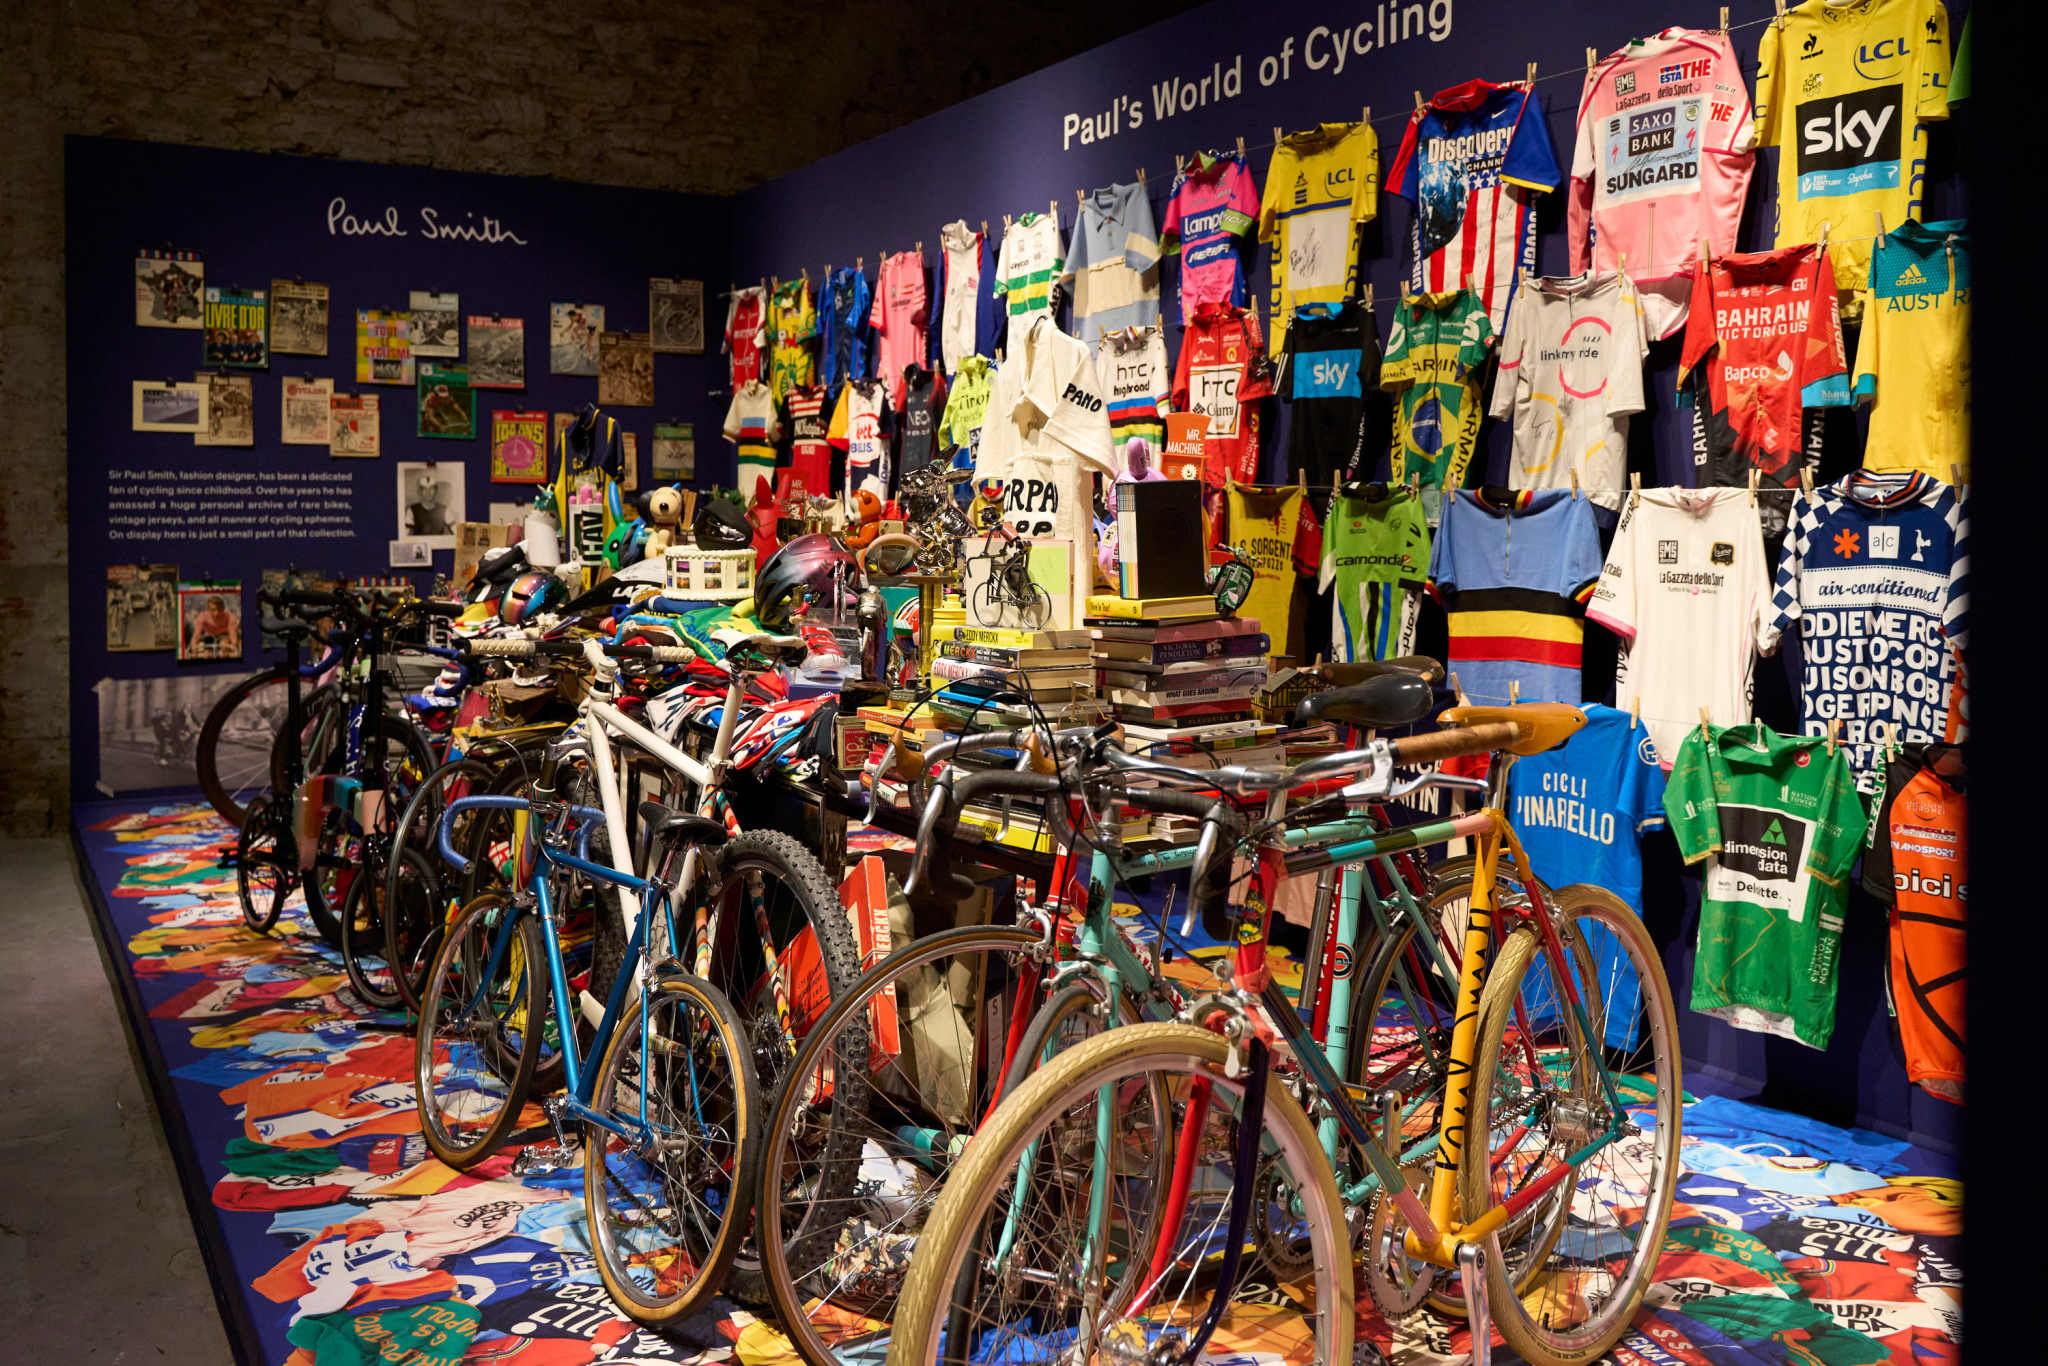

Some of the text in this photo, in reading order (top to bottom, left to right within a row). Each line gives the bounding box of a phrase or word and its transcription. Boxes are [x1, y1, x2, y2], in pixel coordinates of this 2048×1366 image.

[1859, 37, 1911, 64] LCL
[1063, 0, 1453, 151] Paul's World of Cycling
[1660, 58, 1711, 85] ESTA THE
[1673, 82, 1693, 98] Sport
[1632, 110, 1674, 134] SAXO
[1804, 101, 1896, 158] sky
[1632, 130, 1673, 152] BANK
[1465, 157, 1505, 172] CHANN
[1327, 168, 1355, 186] LCL
[1606, 161, 1698, 194] SUNGARD
[326, 197, 528, 246] Paul Smith
[1895, 275, 1928, 287] adidas
[206, 303, 265, 330] LIVRE D'OR
[1716, 299, 1810, 329] BAHRAIN
[1716, 320, 1808, 341] VICTORIOUS
[1313, 358, 1350, 391] sky
[1724, 365, 1771, 385] Bapco
[1062, 382, 1102, 413] PANO
[1167, 441, 1204, 456] MACHINE
[108, 470, 121, 481] Sir
[125, 470, 146, 481] Paul
[148, 470, 178, 481] Smith,
[179, 470, 214, 481] fashion
[215, 470, 258, 481] designer,
[259, 470, 276, 481] has
[277, 470, 300, 481] been
[308, 470, 353, 481] dedicated
[108, 485, 125, 496] fan
[139, 485, 174, 496] cycling
[176, 485, 202, 496] since
[204, 485, 253, 496] childhood.
[256, 485, 278, 496] Over
[279, 485, 295, 496] the
[296, 485, 321, 496] years
[336, 485, 353, 496] has
[108, 500, 156, 510] amassed
[170, 500, 197, 510] huge
[200, 500, 244, 510] personal
[247, 500, 285, 510] archive
[300, 500, 321, 510] rare
[324, 500, 352, 510] bikes,
[108, 515, 146, 526] vintage
[147, 515, 185, 526] jerseys,
[187, 515, 206, 526] and
[207, 515, 219, 526] all
[221, 515, 257, 526] manner
[270, 515, 303, 526] cycling
[304, 515, 353, 526] ephemera.
[126, 529, 162, 541] display
[164, 529, 187, 541] here
[198, 529, 217, 541] just
[227, 529, 253, 541] small
[255, 529, 275, 541] part
[288, 529, 307, 541] that
[309, 529, 358, 541] collection.
[1818, 575, 1943, 603] air-conditioned
[943, 645, 977, 660] MERCKX
[1542, 772, 1587, 799] CICLI
[1724, 840, 1788, 863] dimension
[1758, 859, 1788, 875] data
